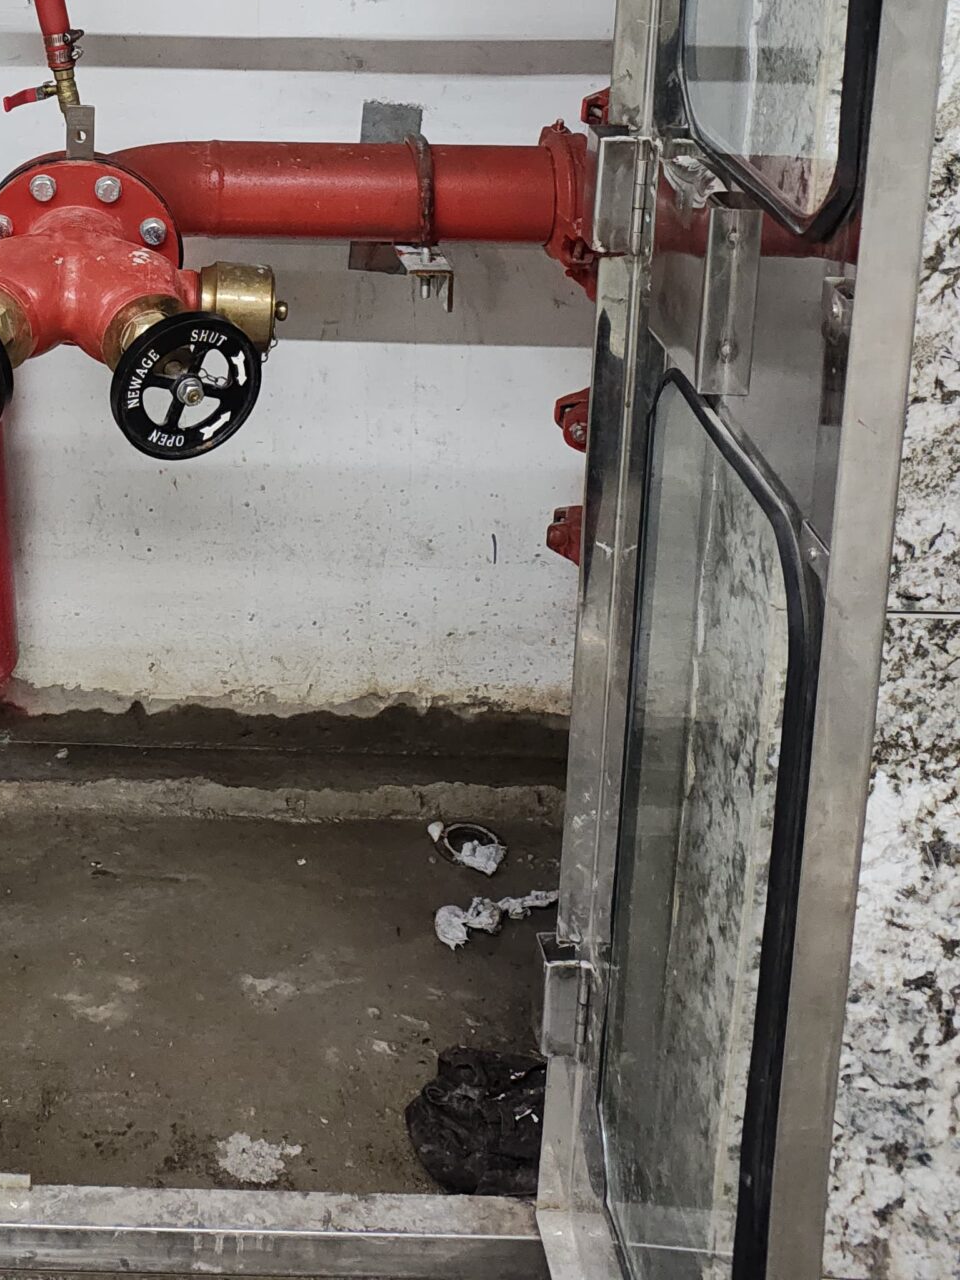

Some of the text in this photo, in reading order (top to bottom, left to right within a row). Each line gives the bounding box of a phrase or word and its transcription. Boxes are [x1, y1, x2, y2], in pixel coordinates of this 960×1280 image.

[190, 329, 228, 346] SHUT
[127, 349, 160, 409] NEWAGE
[147, 429, 185, 447] OPEN
